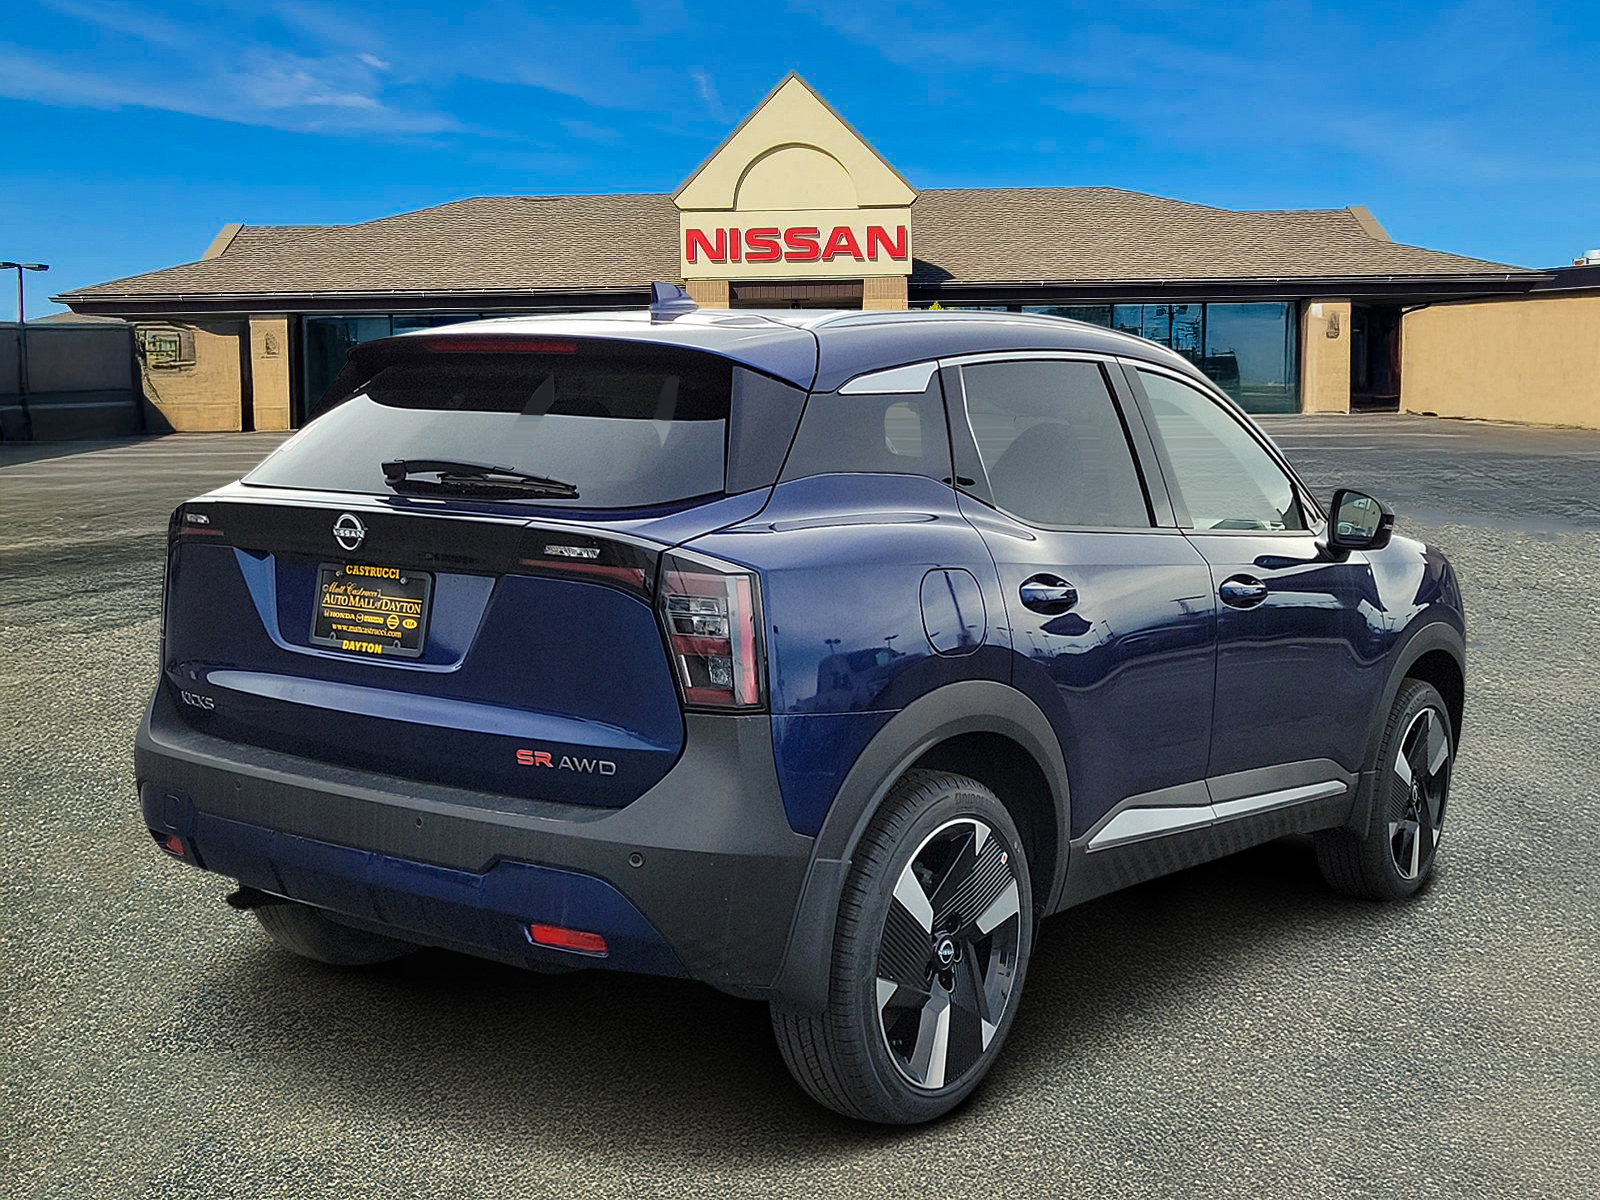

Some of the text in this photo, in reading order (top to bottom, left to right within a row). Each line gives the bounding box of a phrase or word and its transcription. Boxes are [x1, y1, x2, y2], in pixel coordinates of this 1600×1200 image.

[685, 224, 908, 264] NISSAN
[332, 527, 365, 538] NISSAN
[345, 564, 400, 579] CASTRUCCI
[381, 599, 422, 615] DAYTON
[329, 611, 356, 620] HONDA
[342, 640, 383, 654] DAYTON
[516, 749, 616, 776] SR AWD
